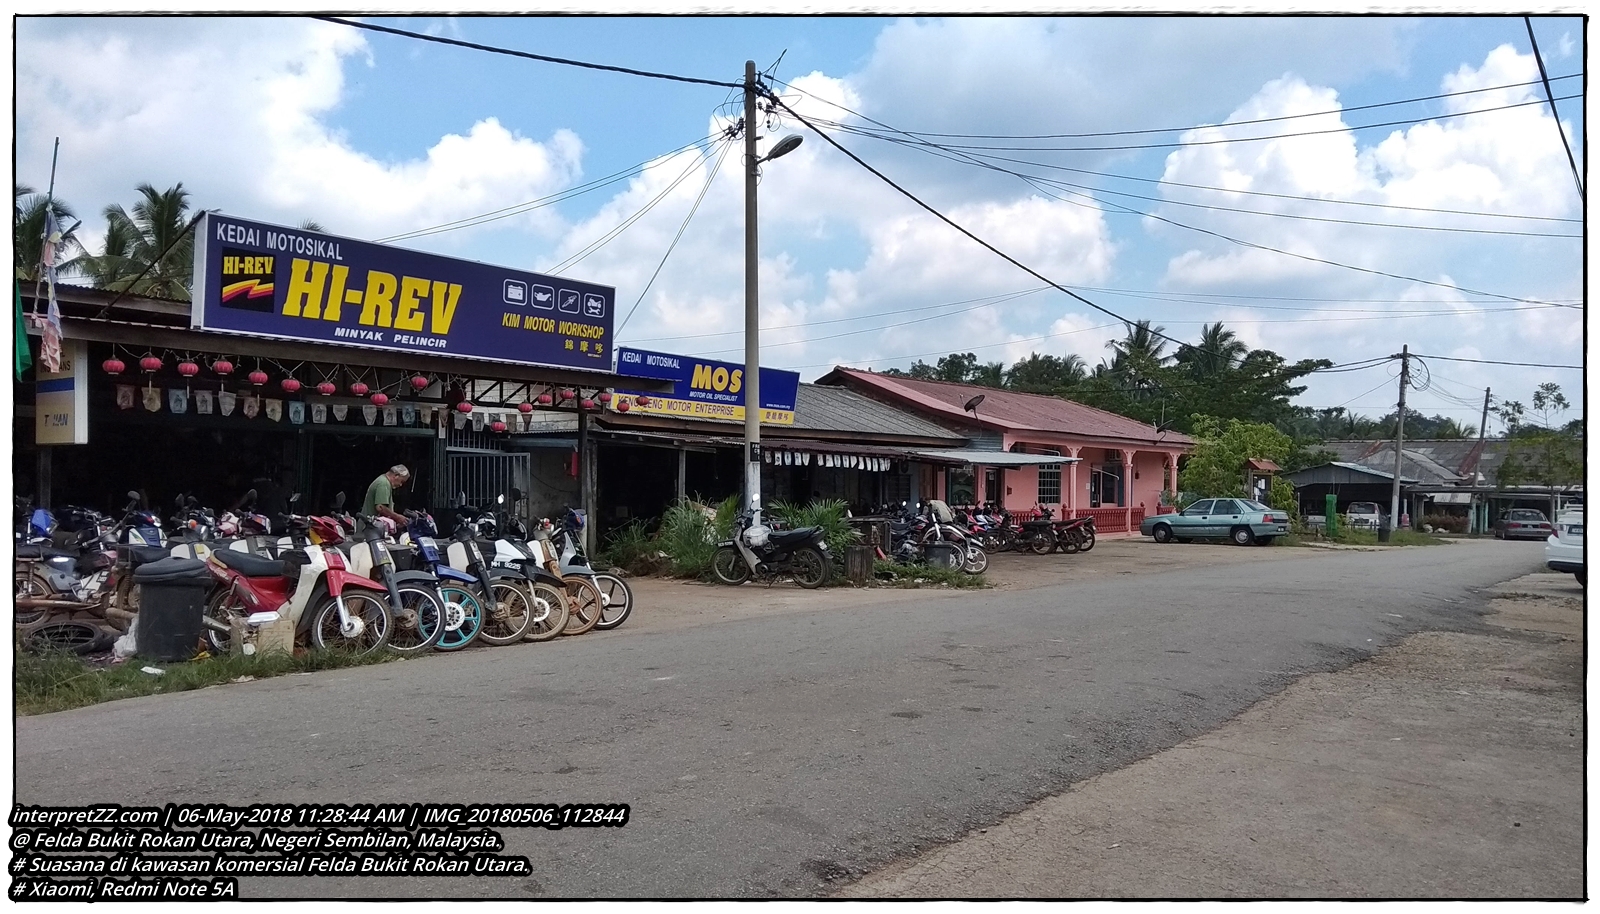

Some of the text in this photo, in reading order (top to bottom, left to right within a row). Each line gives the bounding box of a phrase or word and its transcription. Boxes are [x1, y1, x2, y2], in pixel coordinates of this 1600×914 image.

[216, 222, 343, 260] KEDAI MOTOSIKAL
[223, 256, 274, 275] HI-REV
[282, 257, 463, 335] HI-REV
[502, 312, 604, 339] KIM MOTOR WORKSHOP
[334, 327, 447, 348] MINYAK PELINCIR
[622, 352, 681, 369] KEDAI MOTOSIKAL
[690, 363, 743, 393] MOS
[689, 391, 706, 399] MOTOR
[713, 394, 738, 402] SPECIALIST
[667, 401, 692, 413] MOTOR
[695, 403, 735, 416] ENTERPRISE
